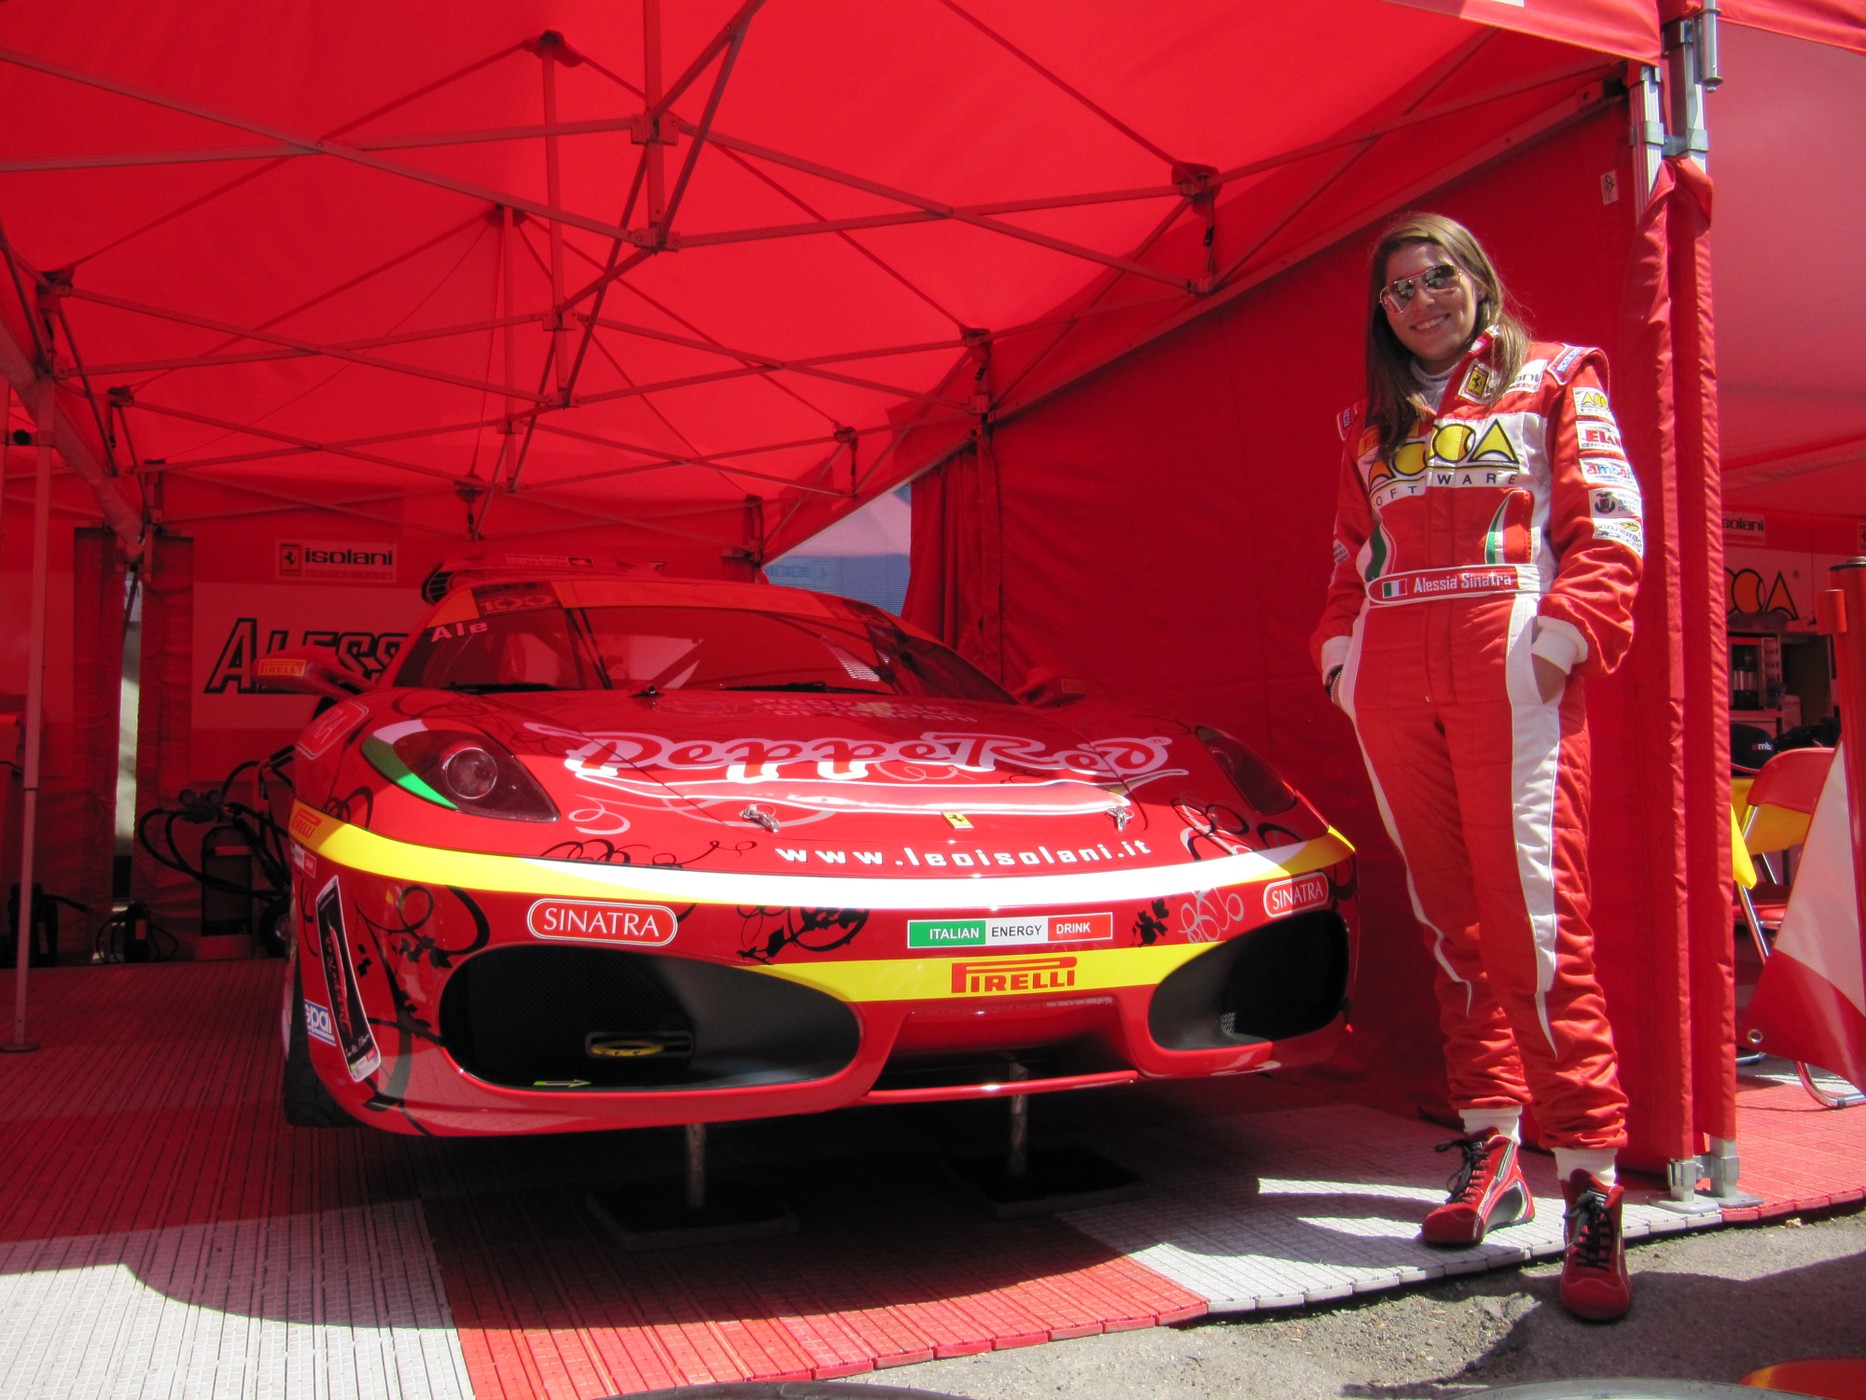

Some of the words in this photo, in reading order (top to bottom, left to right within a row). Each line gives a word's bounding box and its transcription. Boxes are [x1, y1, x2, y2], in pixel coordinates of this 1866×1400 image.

[1722, 517, 1764, 532] solani
[304, 547, 394, 566] isolani
[1413, 574, 1457, 594] Alessia
[1461, 572, 1512, 589] Sinatra
[431, 621, 489, 643] Ale
[775, 839, 1152, 867] www.leoisolani.it
[1271, 880, 1324, 911] SINATRA
[543, 907, 660, 938] SINATRA
[929, 927, 980, 940] ITALIAN
[991, 924, 1042, 938] ENERGY
[1055, 921, 1091, 935] DRINK
[951, 956, 1078, 994] PIRELLI
